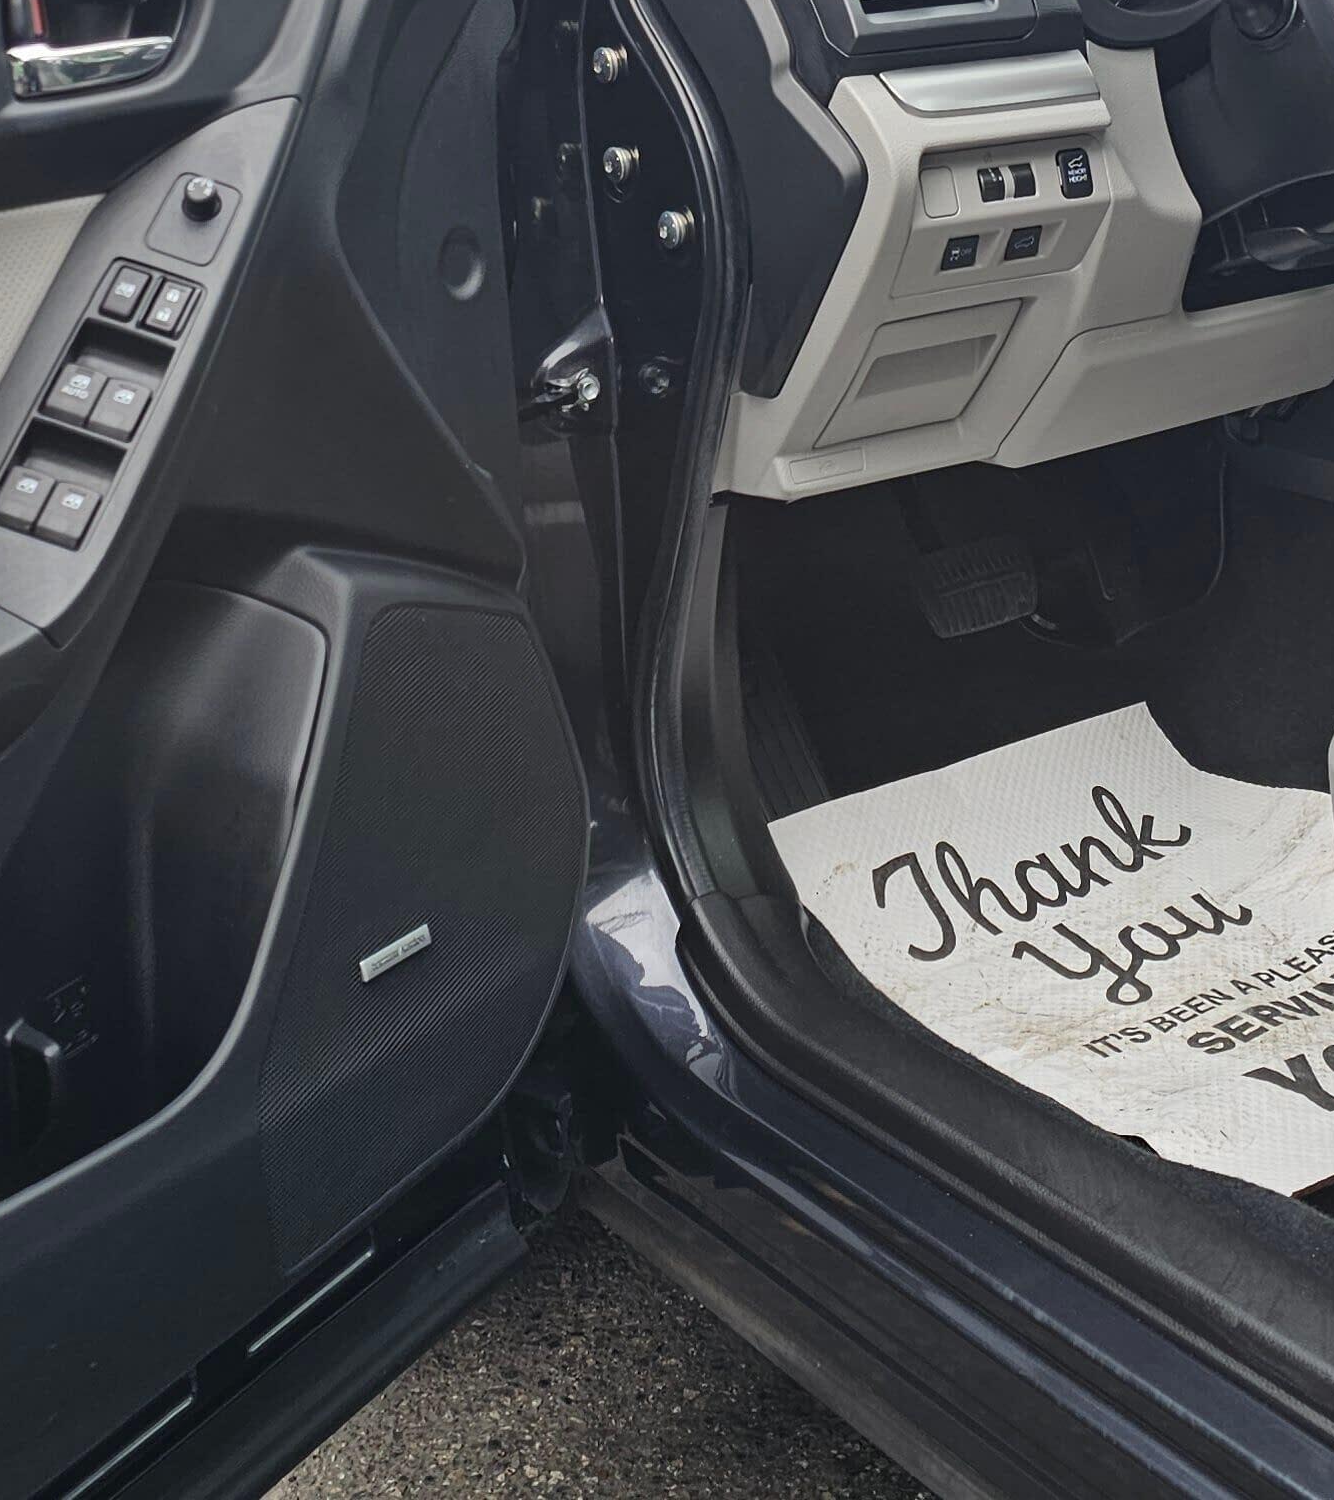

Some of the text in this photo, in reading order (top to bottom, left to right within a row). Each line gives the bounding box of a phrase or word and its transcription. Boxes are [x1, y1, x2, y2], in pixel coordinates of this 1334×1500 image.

[872, 786, 1192, 961] Thank
[1012, 893, 1252, 1005] You
[1083, 1026, 1152, 1058] IT'S
[1145, 989, 1235, 1033] BEEN
[1230, 979, 1261, 995] A
